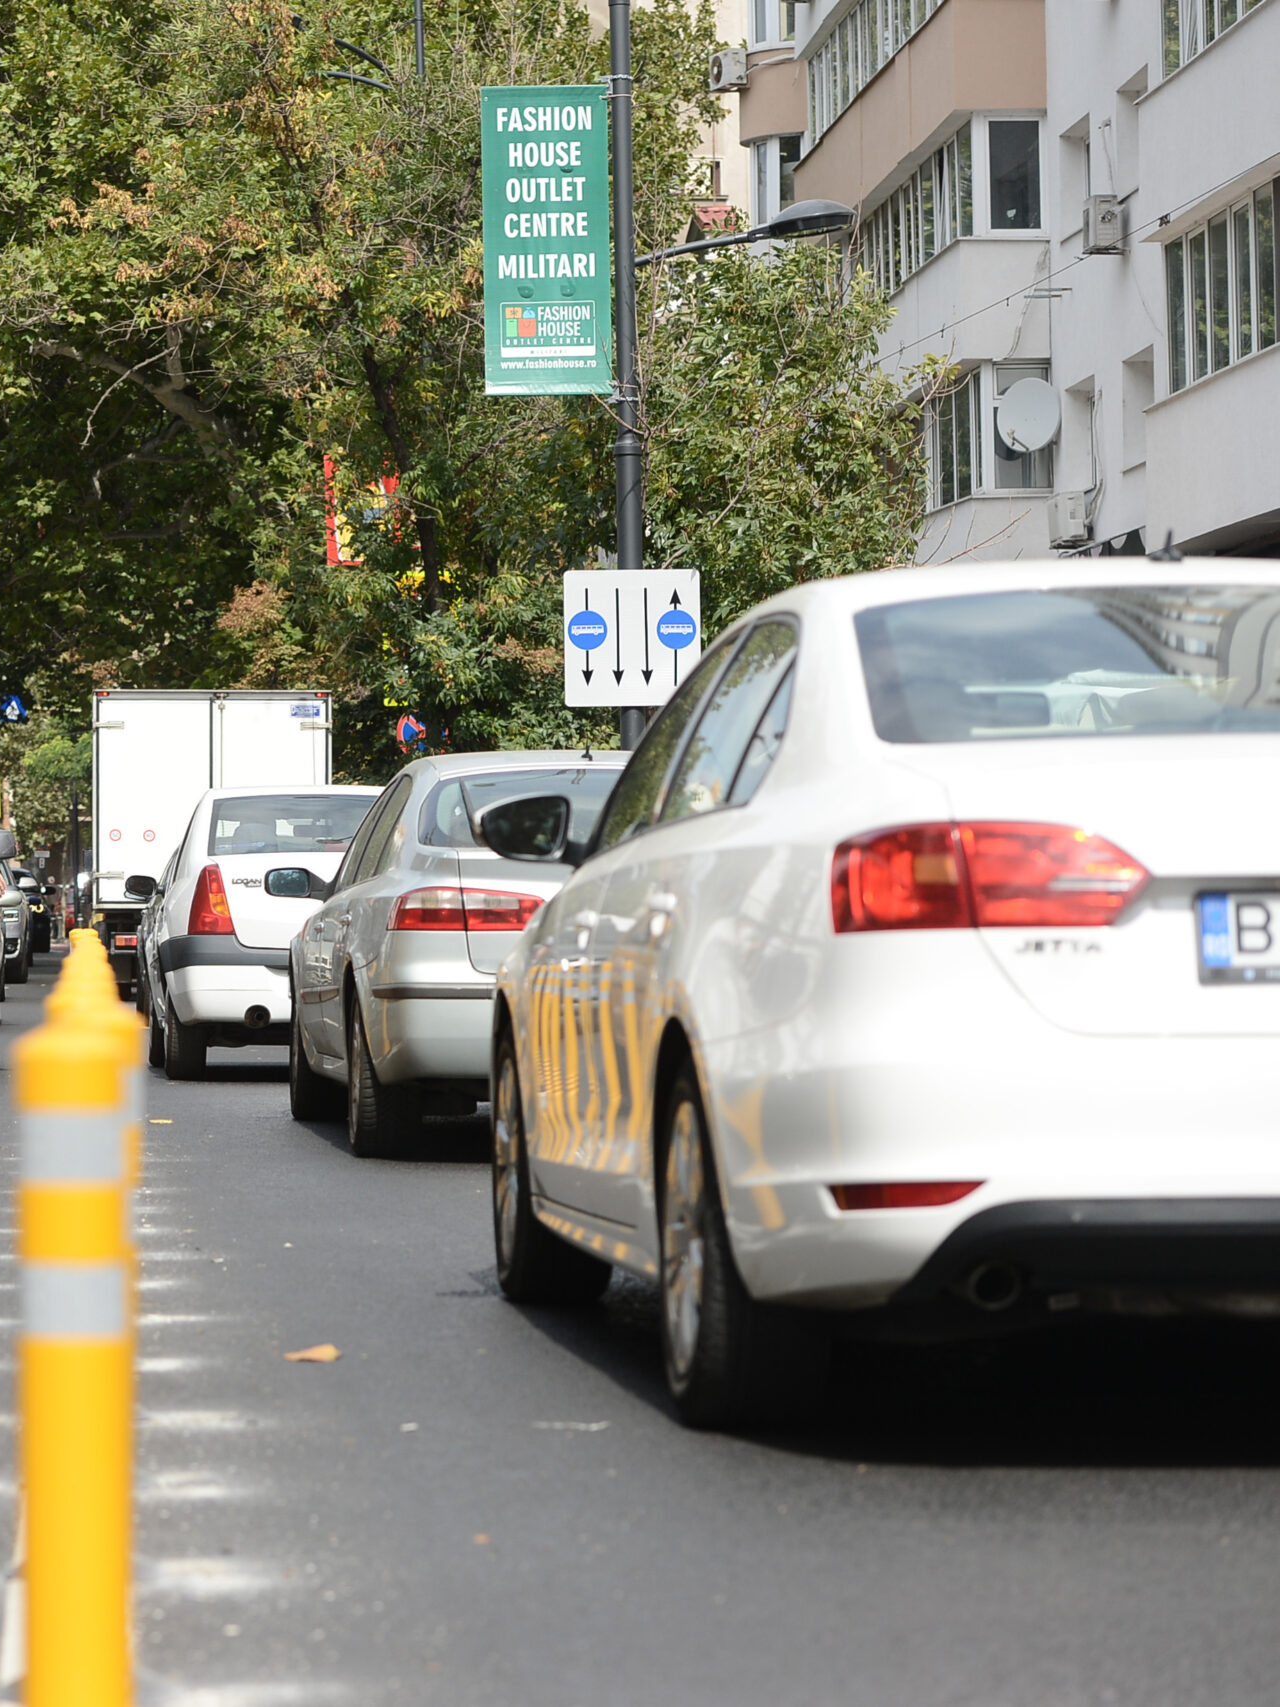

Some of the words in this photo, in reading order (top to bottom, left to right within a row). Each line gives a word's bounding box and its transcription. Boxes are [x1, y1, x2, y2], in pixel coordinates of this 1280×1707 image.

[496, 105, 592, 132] FASHION
[508, 141, 581, 167] HOUSE
[505, 177, 586, 203] OUTLET
[504, 212, 588, 238] CENTRE
[498, 252, 595, 279] MILITARI
[537, 305, 590, 321] FASHION
[537, 321, 581, 337] HOUSE
[505, 338, 544, 346] OUTLET
[552, 336, 592, 345] CENTRE
[500, 358, 597, 370] www.fashionhouse.ro
[1015, 938, 1103, 954] JETTA
